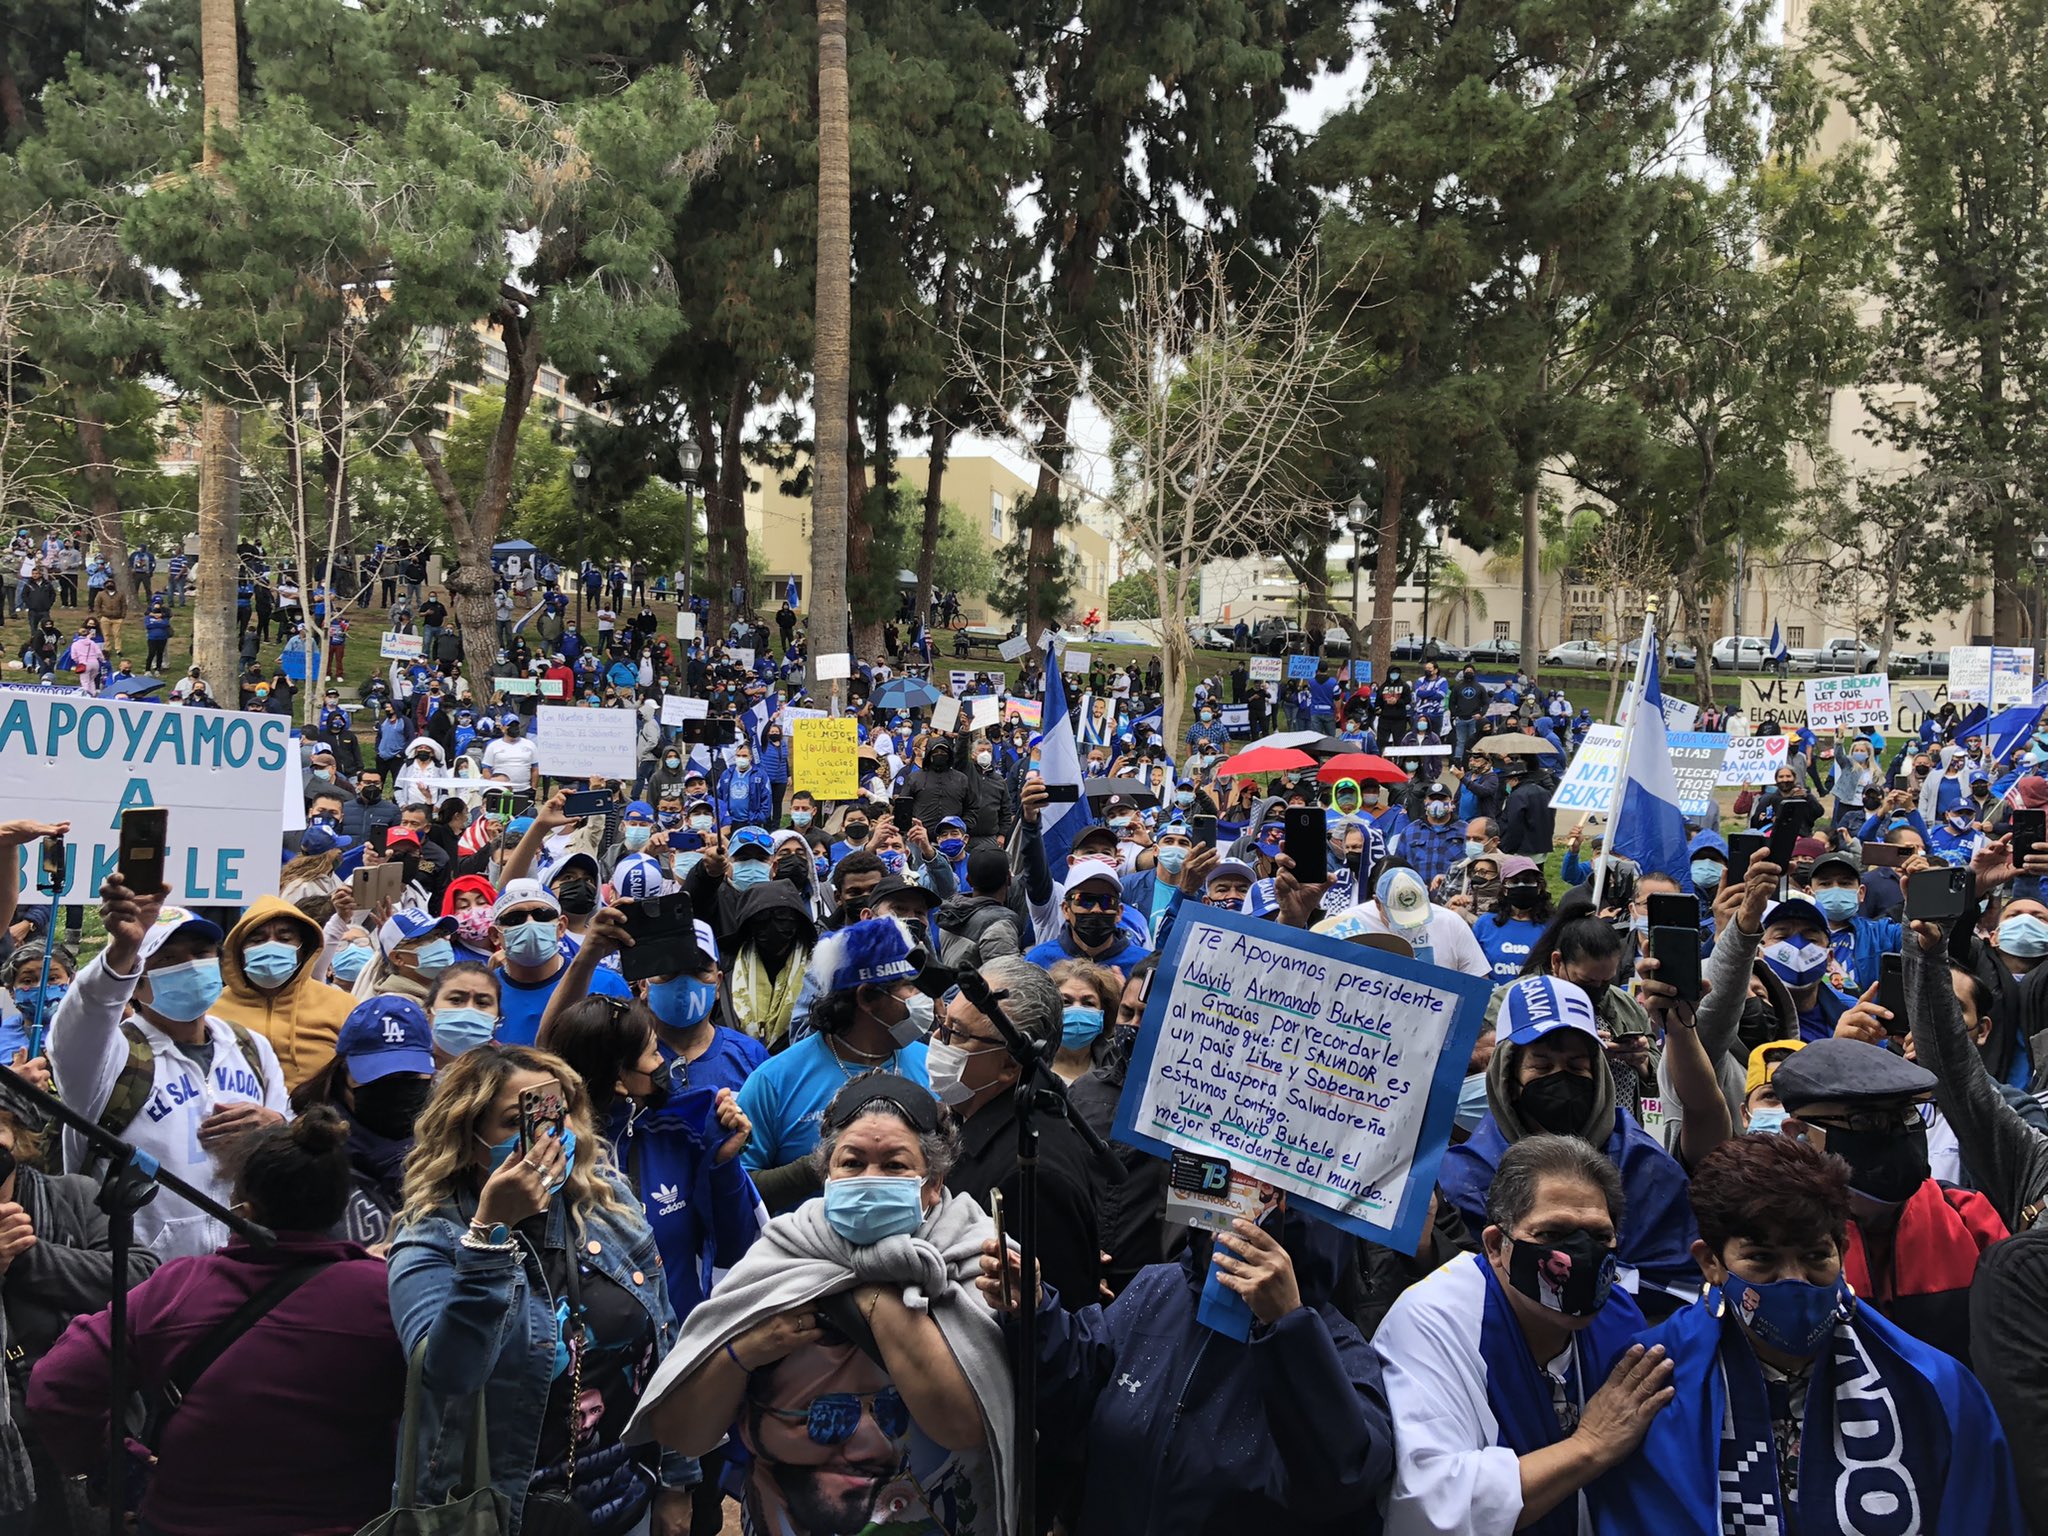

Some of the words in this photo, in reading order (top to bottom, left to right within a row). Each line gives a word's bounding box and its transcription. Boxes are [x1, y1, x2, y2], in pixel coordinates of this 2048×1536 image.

[1814, 681, 1837, 691] JOE
[1815, 691, 1835, 701] LET
[1840, 690, 1862, 699] OUR
[800, 719, 845, 730] BUKELE
[1769, 708, 1808, 727] SALVA
[1811, 716, 1827, 726] DO
[1860, 711, 1889, 723] JOB
[0, 699, 287, 771] APOYAMOS
[1585, 736, 1622, 748] SUPPO
[1727, 738, 1764, 748] GOOD
[1668, 747, 1711, 759] ACIAS
[1738, 749, 1764, 760] JOB
[1576, 763, 1618, 783] NAY
[1672, 767, 1719, 779] OTEGER
[1720, 761, 1784, 772] BANCADA
[1726, 772, 1764, 782] CYAN
[110, 778, 157, 830] A
[1556, 783, 1614, 809] BUKE
[1501, 942, 1530, 954] Que
[858, 966, 874, 980] EL
[875, 959, 916, 979] SALVA
[1231, 934, 1326, 981] Apoyamos
[1335, 973, 1444, 1012] presidente
[1494, 961, 1525, 975] Chiv
[686, 988, 707, 1020] N
[1184, 960, 1232, 992] Nayib
[1244, 977, 1322, 1016] Armando
[1326, 1001, 1392, 1037] Bukele
[1520, 980, 1553, 1021] SALVA
[381, 1016, 405, 1043] LA
[1201, 993, 1259, 1025] Gracias
[1269, 1014, 1301, 1036] por
[1305, 1025, 1399, 1068] recordarle
[1170, 1027, 1194, 1045] un
[1199, 1036, 1234, 1058] país
[1245, 1046, 1283, 1073] Libre
[1288, 1065, 1299, 1082] y
[1172, 1003, 1187, 1019] al
[1191, 1010, 1240, 1036] mundo
[1281, 1036, 1300, 1055] El
[1304, 1046, 1377, 1084] SALVADOR
[1387, 1077, 1411, 1094] es
[1161, 1065, 1227, 1100] estamos
[1234, 1095, 1290, 1124] contigo.
[1177, 1048, 1203, 1070] La
[1286, 1088, 1386, 1137] Salvadoreña
[147, 1100, 172, 1123] EL
[1155, 1105, 1203, 1134] mejor
[1210, 1122, 1291, 1167] Presidente
[1296, 1156, 1323, 1178] del
[1222, 1106, 1269, 1136] Nayib
[1276, 1125, 1334, 1159] Bukele
[1342, 1152, 1361, 1168] el
[659, 1199, 687, 1216] adidas
